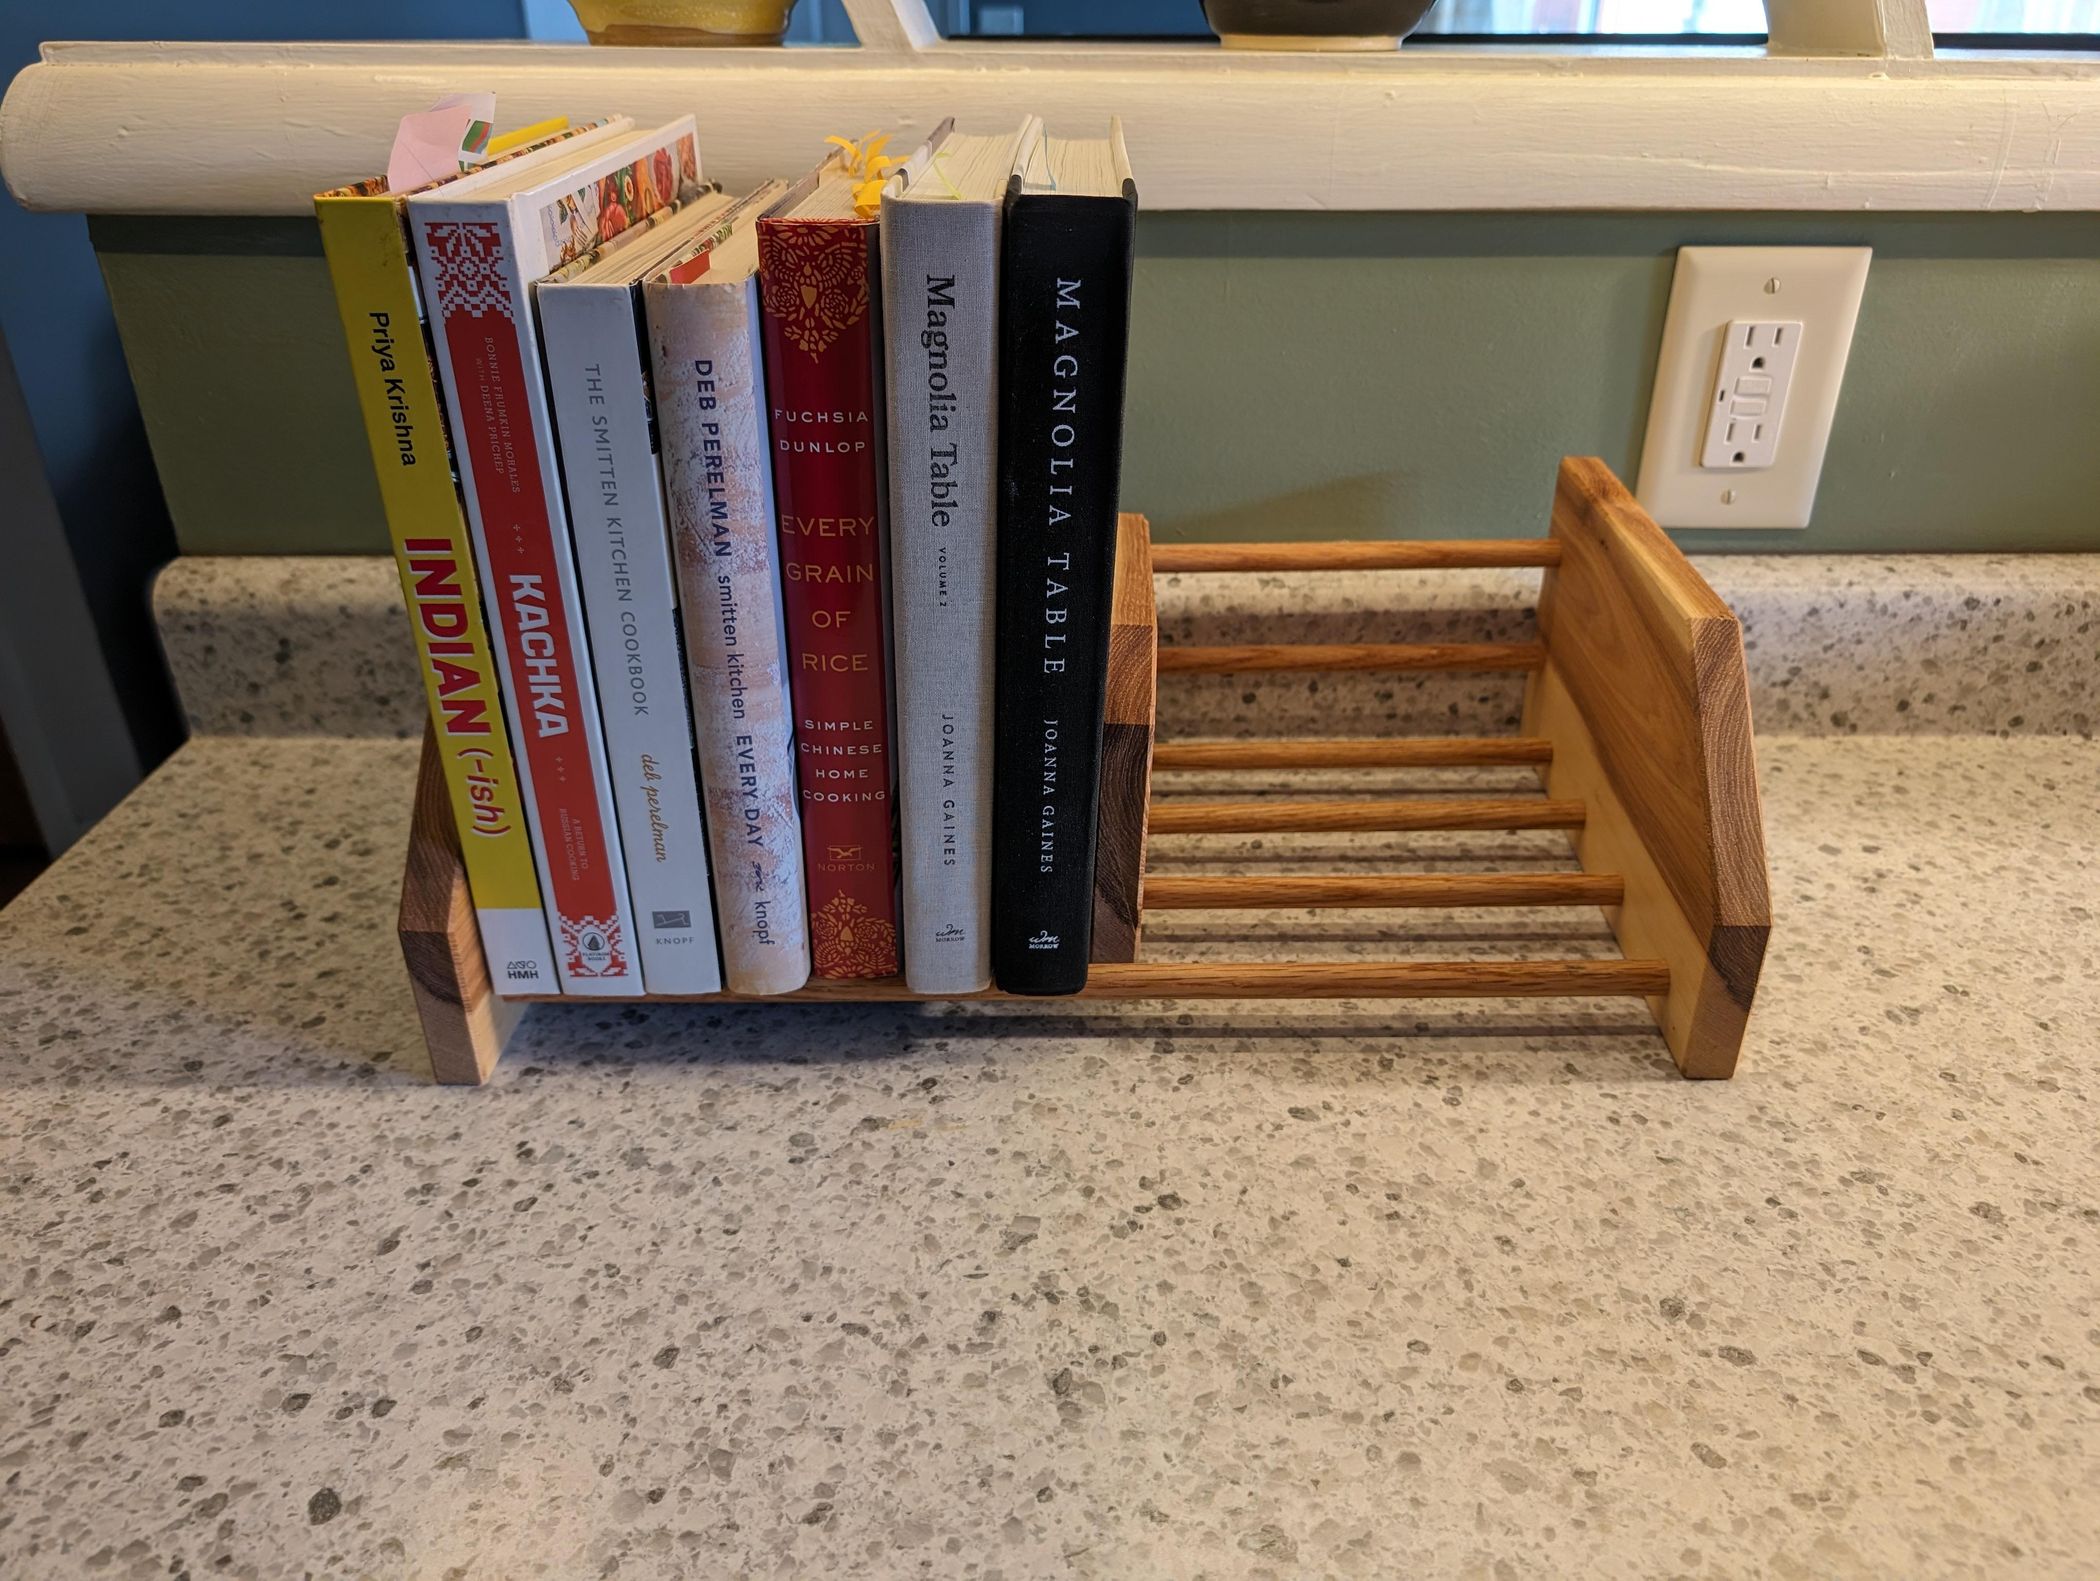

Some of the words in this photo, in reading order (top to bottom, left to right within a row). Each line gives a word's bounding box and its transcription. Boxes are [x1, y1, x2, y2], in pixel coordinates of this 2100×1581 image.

[585, 363, 605, 405] THE
[695, 359, 717, 410] DEB
[921, 274, 957, 433] Magnolia
[369, 312, 396, 372] Priya
[384, 379, 416, 466] Krishna
[485, 336, 500, 382] BONNIE
[495, 385, 511, 438] FRUMKIN
[504, 441, 521, 493] MORALES
[775, 409, 868, 423] FUCHSIA
[1049, 277, 1082, 526] MAGNOLIA
[480, 385, 495, 421] DEENA
[488, 426, 504, 474] PRICHEP
[592, 415, 619, 506] SMITTEN
[780, 439, 865, 453] DUNLOP
[702, 422, 732, 557] PERELMAN
[930, 442, 959, 527] Table
[781, 514, 875, 537] EVERY
[607, 517, 632, 602] KITCHEN
[786, 562, 874, 584] GRAIN
[939, 547, 947, 596] VOLUME
[718, 575, 738, 647] smitten
[811, 610, 850, 628] OF
[1044, 552, 1070, 674] TABLE
[404, 538, 492, 736] INDIAN
[457, 748, 511, 838] (-ish)
[509, 574, 569, 738] KACHKA
[620, 611, 649, 716] COOKBOOK
[727, 653, 748, 719] kitchen
[802, 653, 868, 672] RICE
[801, 742, 883, 755] CHINESE
[805, 719, 873, 731] SIMPLE
[942, 714, 955, 788] JOANNA
[1043, 719, 1059, 795] JOANNA
[641, 753, 663, 782] deb
[736, 735, 759, 799] EVERY
[803, 790, 886, 802] COOKING
[815, 768, 868, 779] HOME
[640, 784, 669, 863] perelman
[744, 808, 764, 847] DAY
[943, 800, 956, 866] GAINES
[1041, 805, 1055, 873] GAINES
[818, 863, 876, 872] NORTON
[656, 937, 695, 945] KNOPF
[752, 900, 775, 945] knopf
[507, 970, 539, 980] HMH
